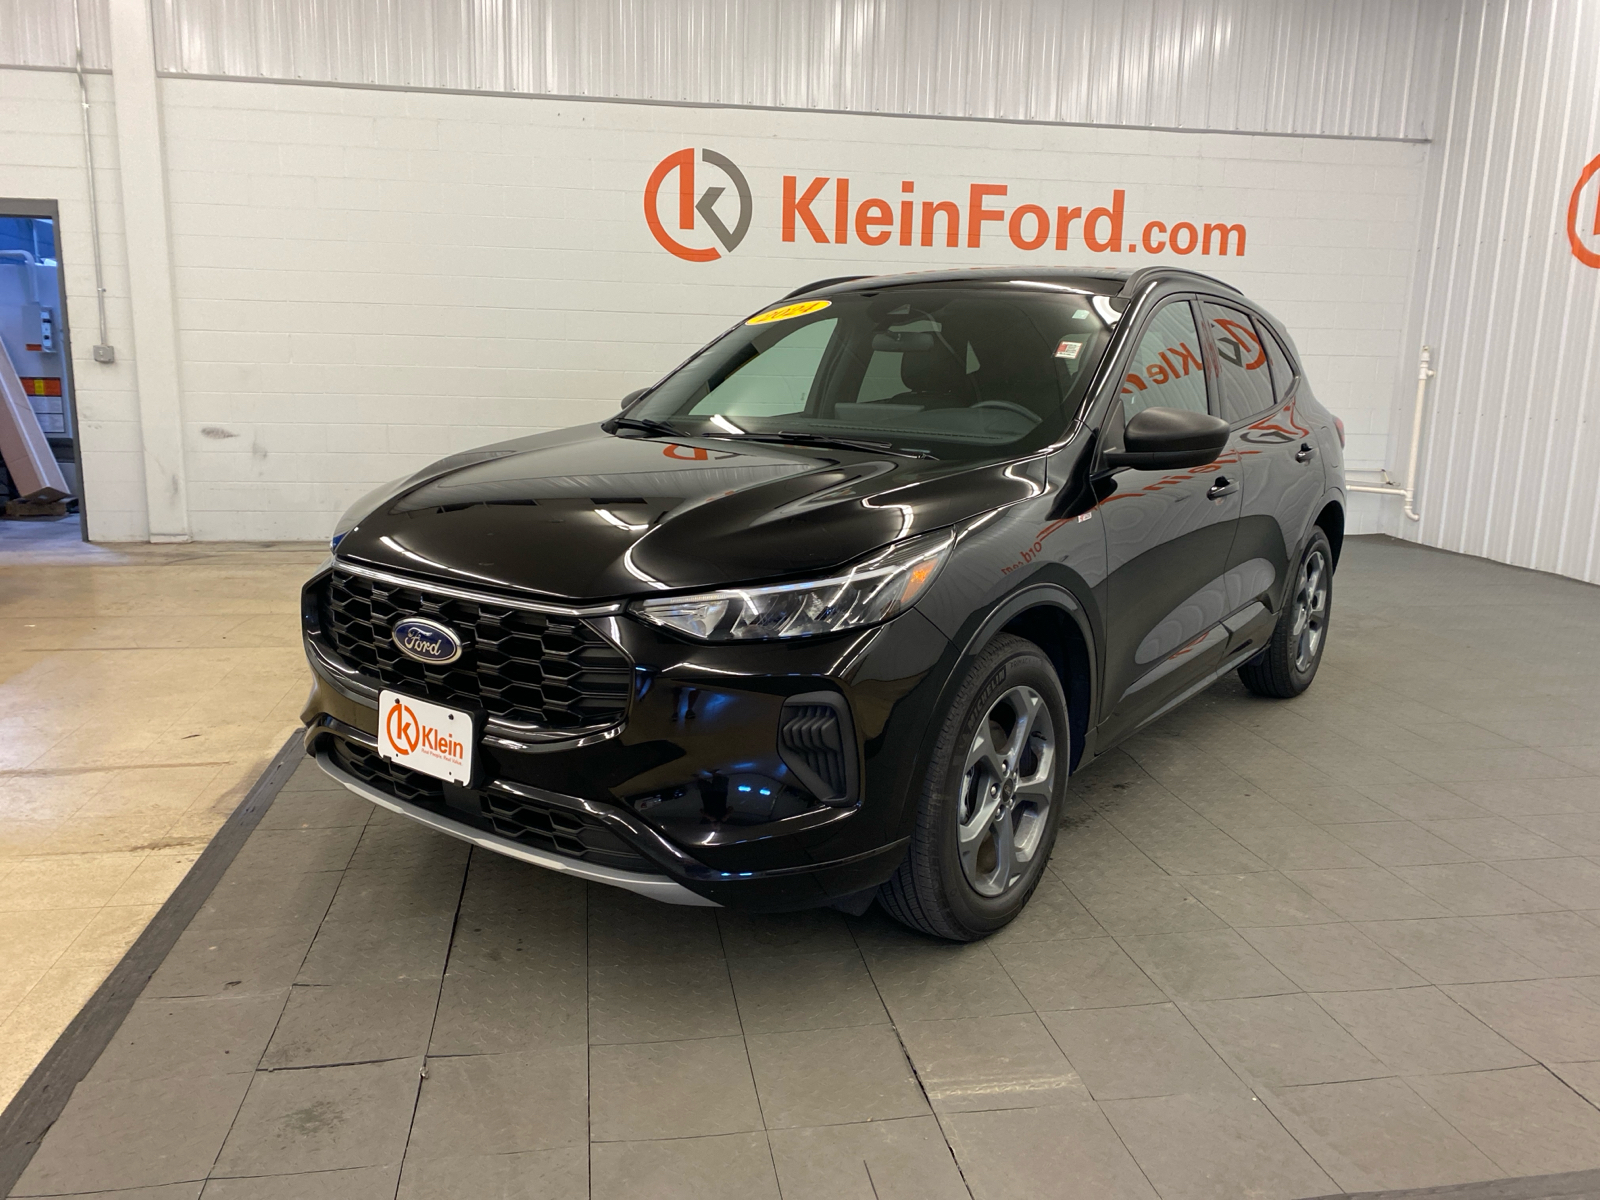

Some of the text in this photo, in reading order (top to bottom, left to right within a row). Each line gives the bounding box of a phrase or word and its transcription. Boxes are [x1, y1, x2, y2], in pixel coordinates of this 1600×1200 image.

[781, 175, 1246, 256] KleinFord.com
[756, 302, 821, 323] 2024
[404, 627, 442, 655] Ford
[967, 668, 1005, 730] MICHELIN
[421, 725, 464, 759] Klein
